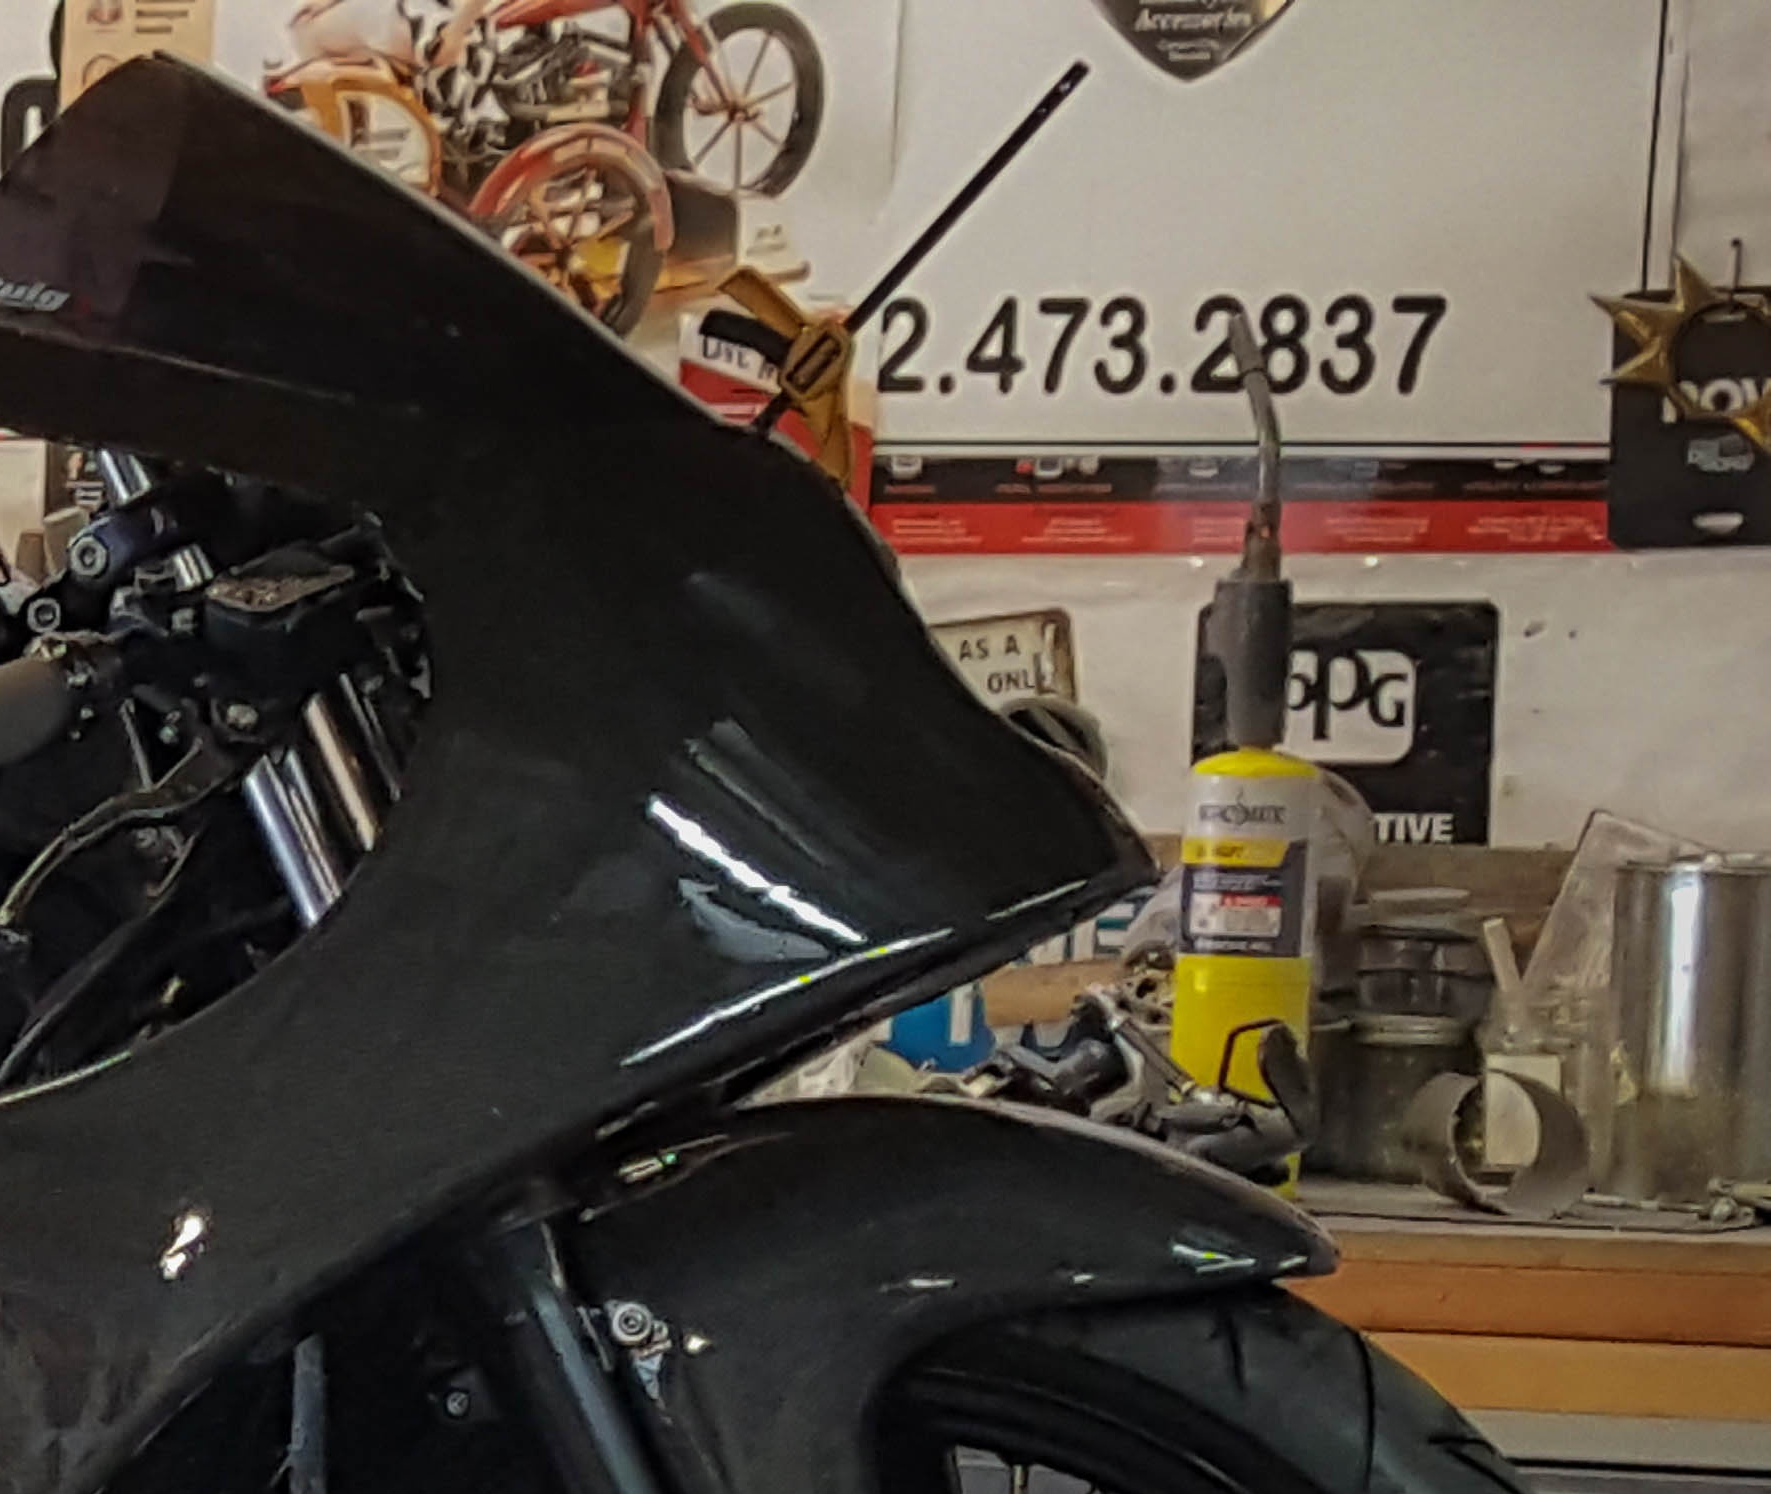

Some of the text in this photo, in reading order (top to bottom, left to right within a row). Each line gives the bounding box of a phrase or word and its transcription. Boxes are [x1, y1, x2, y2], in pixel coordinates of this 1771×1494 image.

[876, 294, 1448, 394] 2.473.2837
[959, 634, 1031, 663] AS A
[986, 668, 1036, 694] ONL
[1373, 812, 1455, 844] TIVE
